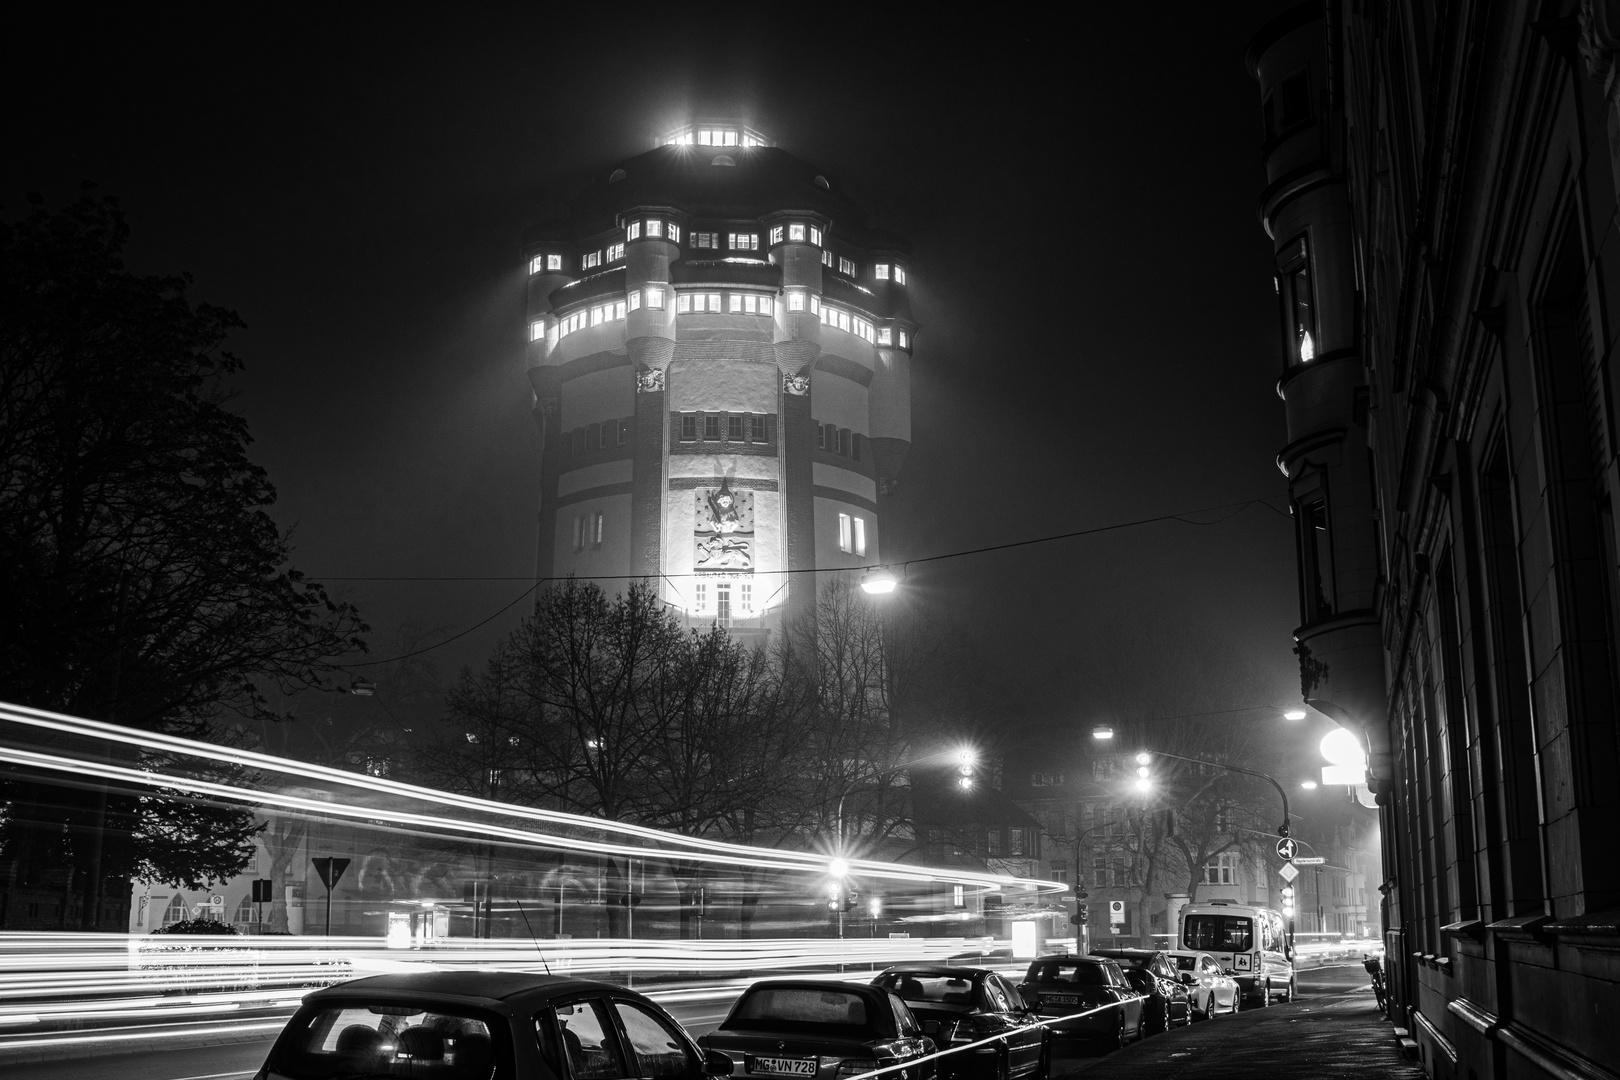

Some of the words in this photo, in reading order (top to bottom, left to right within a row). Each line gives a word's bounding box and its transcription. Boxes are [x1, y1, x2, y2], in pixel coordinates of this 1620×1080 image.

[755, 1058, 770, 1070] MG
[777, 1060, 792, 1072] VN
[794, 1061, 815, 1073] 728
